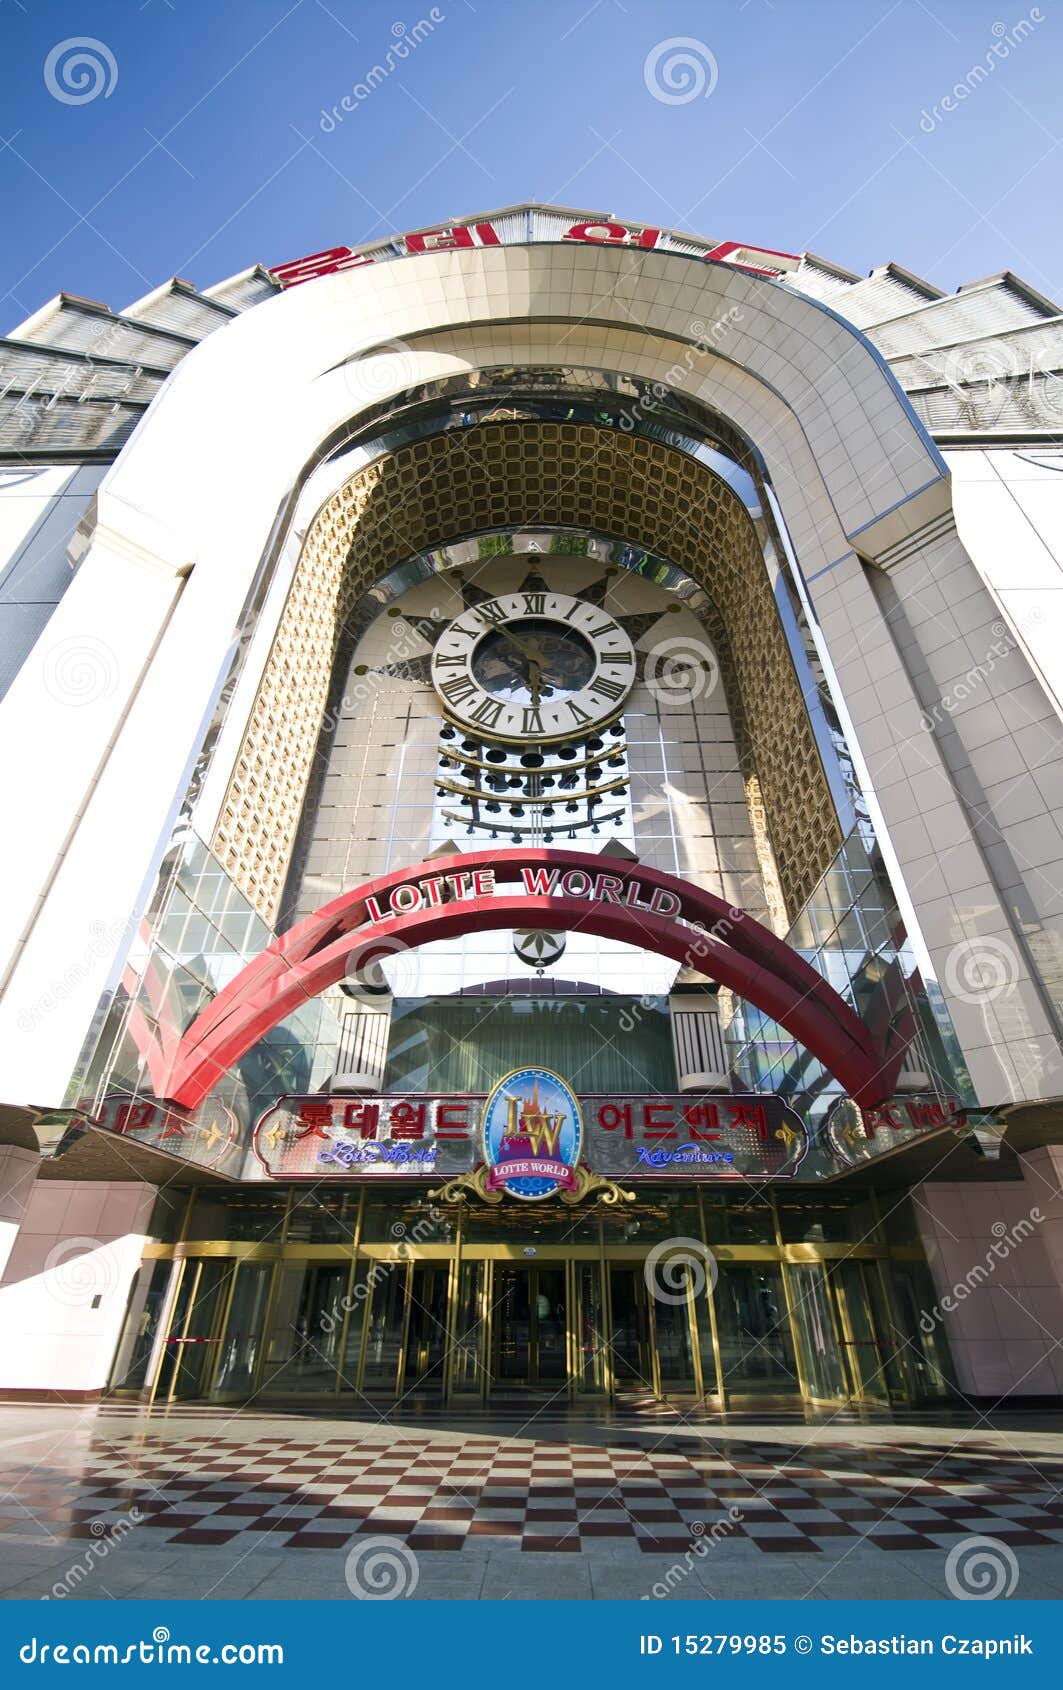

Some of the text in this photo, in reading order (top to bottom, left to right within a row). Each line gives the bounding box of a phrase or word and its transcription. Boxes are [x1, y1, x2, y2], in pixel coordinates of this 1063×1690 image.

[522, 593, 547, 615] XII
[365, 867, 682, 925] LOTTE WORLD
[295, 1103, 469, 1140] 롯데월드
[317, 1141, 438, 1169] Lotte World
[636, 1142, 734, 1168] Adventure
[494, 1162, 569, 1177] LOTTE WORLD
